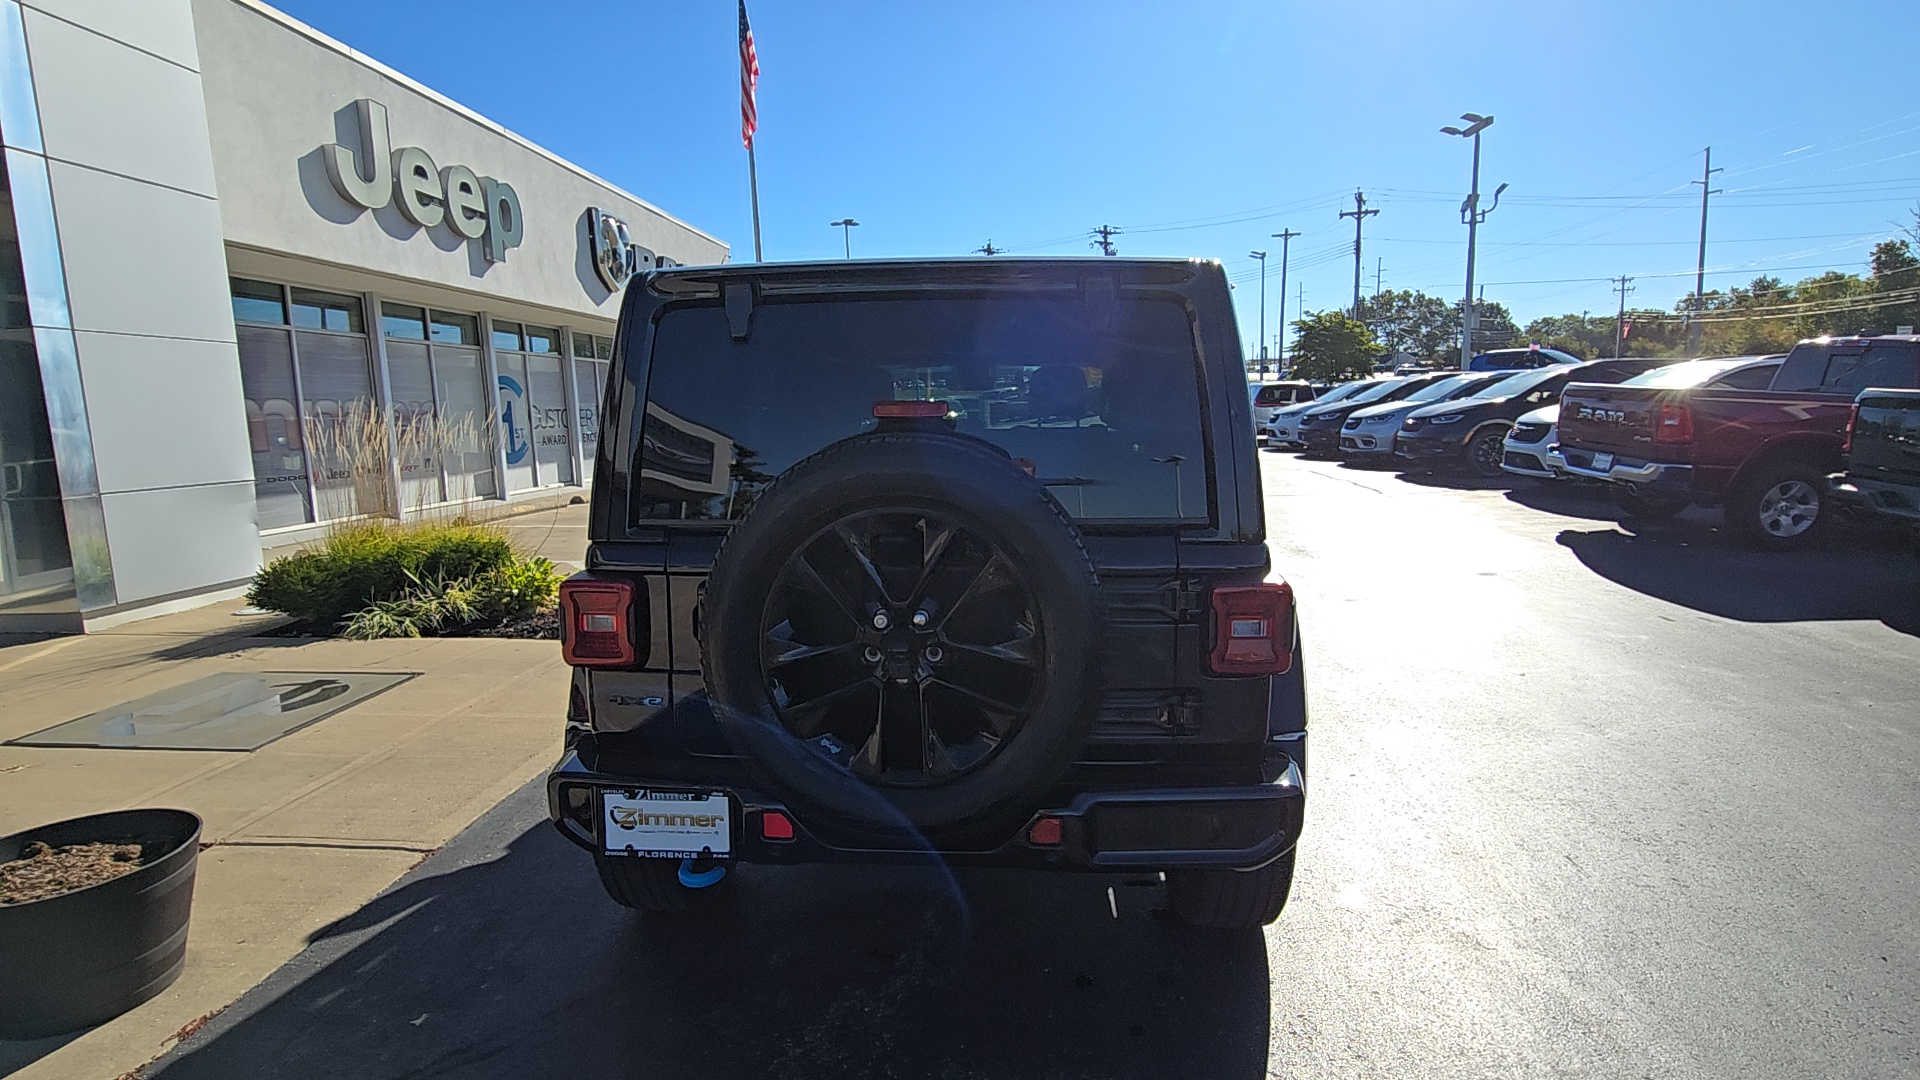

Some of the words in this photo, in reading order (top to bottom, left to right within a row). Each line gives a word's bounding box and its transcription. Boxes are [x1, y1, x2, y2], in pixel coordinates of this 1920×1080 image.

[323, 98, 523, 263] Jeep
[532, 403, 594, 430] CUSTOER
[541, 434, 567, 446] AWARD
[266, 474, 307, 483] DODG
[634, 788, 696, 801] Zimmer
[615, 807, 725, 828] Zimmer
[637, 851, 699, 859] FLORENCE
